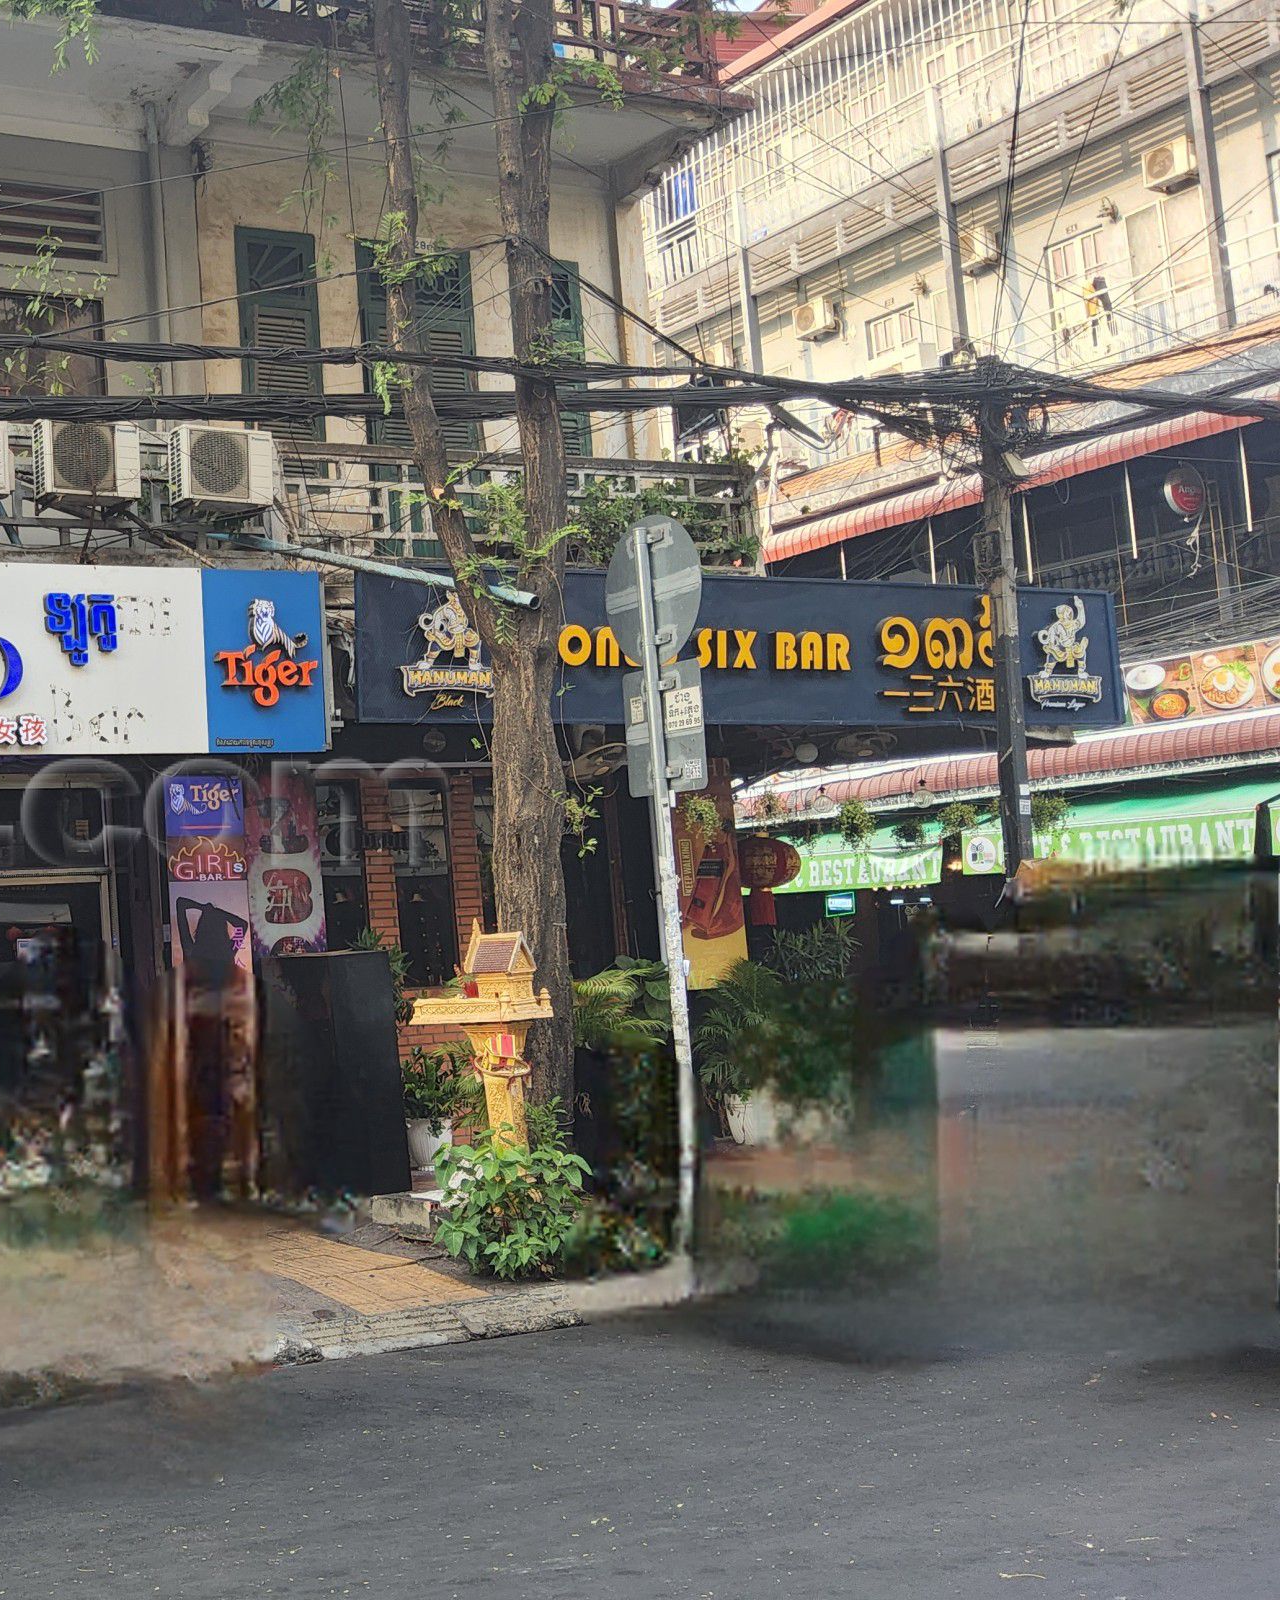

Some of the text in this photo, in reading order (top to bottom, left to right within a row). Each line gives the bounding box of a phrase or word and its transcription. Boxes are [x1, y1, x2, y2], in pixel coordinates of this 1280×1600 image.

[696, 627, 757, 671] SIX
[775, 630, 852, 672] BAR
[214, 644, 318, 706] Tiger
[408, 669, 492, 687] HANUMAN
[1034, 678, 1098, 694] HANUMAN
[431, 694, 465, 711] Black
[189, 782, 240, 811] Tiger
[199, 873, 224, 882] BAR
